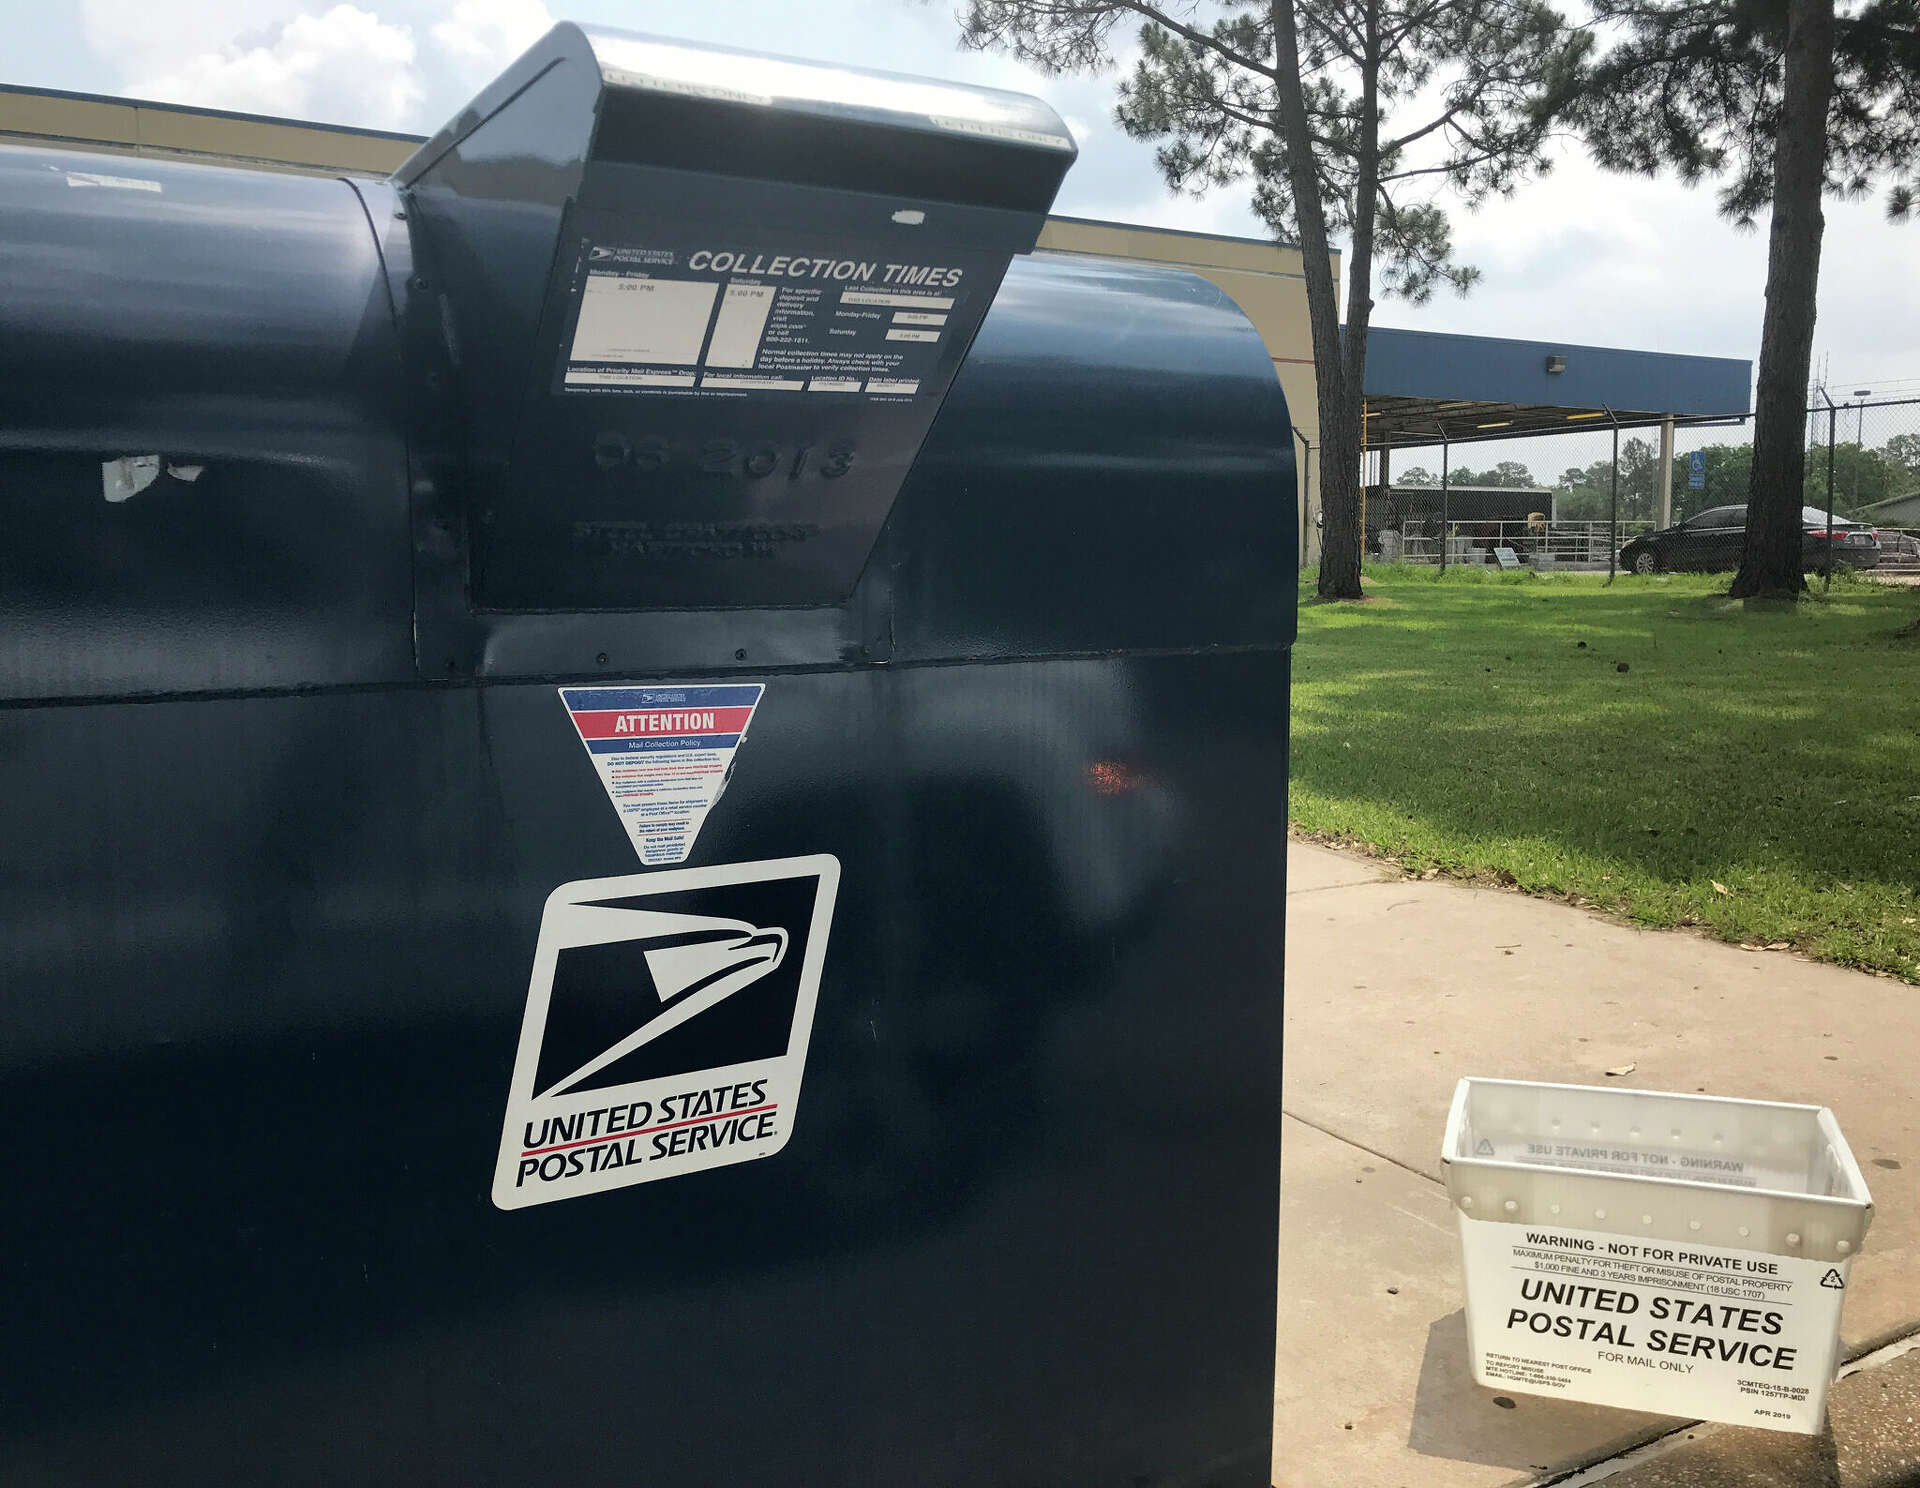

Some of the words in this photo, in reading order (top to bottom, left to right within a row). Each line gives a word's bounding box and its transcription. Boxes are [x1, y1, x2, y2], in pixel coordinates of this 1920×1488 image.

[688, 250, 877, 281] COLLECTION
[883, 264, 963, 287] TIMES
[829, 328, 857, 336] Saturday
[615, 712, 715, 733] ATTENTION
[680, 739, 701, 747] Policy
[523, 1101, 652, 1149] UNITED
[657, 1079, 768, 1123] STATES
[515, 1138, 642, 1187] POSTAL
[649, 1111, 778, 1160] SERVICE
[1526, 1232, 1595, 1251] WARNING
[1608, 1243, 1639, 1257] NOT
[1643, 1247, 1674, 1261] FOR
[1678, 1252, 1742, 1270] PRIVATE
[1747, 1261, 1779, 1275] USE
[1512, 1248, 1554, 1261] MAXIMUM
[1554, 1254, 1593, 1266] PENALTY
[1593, 1259, 1612, 1268] FOR
[1613, 1262, 1642, 1272] THEFT
[1641, 1265, 1656, 1274] OR
[1656, 1268, 1690, 1279] MISUSE
[1691, 1272, 1705, 1281] OF
[1706, 1274, 1741, 1286] POSTAL
[1742, 1279, 1792, 1292] PROPERTY
[1534, 1261, 1560, 1272] $1,000
[1561, 1265, 1582, 1275] FINE
[1581, 1268, 1600, 1277] AND
[1607, 1271, 1636, 1282] YEARS
[1637, 1275, 1706, 1291] IMPRISONMENT
[1706, 1285, 1720, 1293] (18
[1720, 1286, 1741, 1296] USC
[1742, 1289, 1765, 1300] 1707)
[1520, 1278, 1640, 1314] UNITED
[1649, 1296, 1784, 1335] STATES
[1506, 1308, 1636, 1347] POSTAL
[1646, 1329, 1798, 1371] SERVICE
[1486, 1352, 1511, 1361] RETURN
[1521, 1358, 1551, 1368] NEAREST
[1551, 1362, 1568, 1370] POST
[1568, 1365, 1592, 1374] OFFICE
[1495, 1361, 1520, 1370] REPORT
[1521, 1365, 1544, 1374] MISUSE
[1597, 1351, 1624, 1363] FOR
[1626, 1356, 1657, 1369] MAIL
[1659, 1360, 1695, 1374] ONLY
[1740, 1387, 1759, 1395] PSIN
[1754, 1409, 1771, 1417] APR
[1773, 1411, 1792, 1420] 2019
